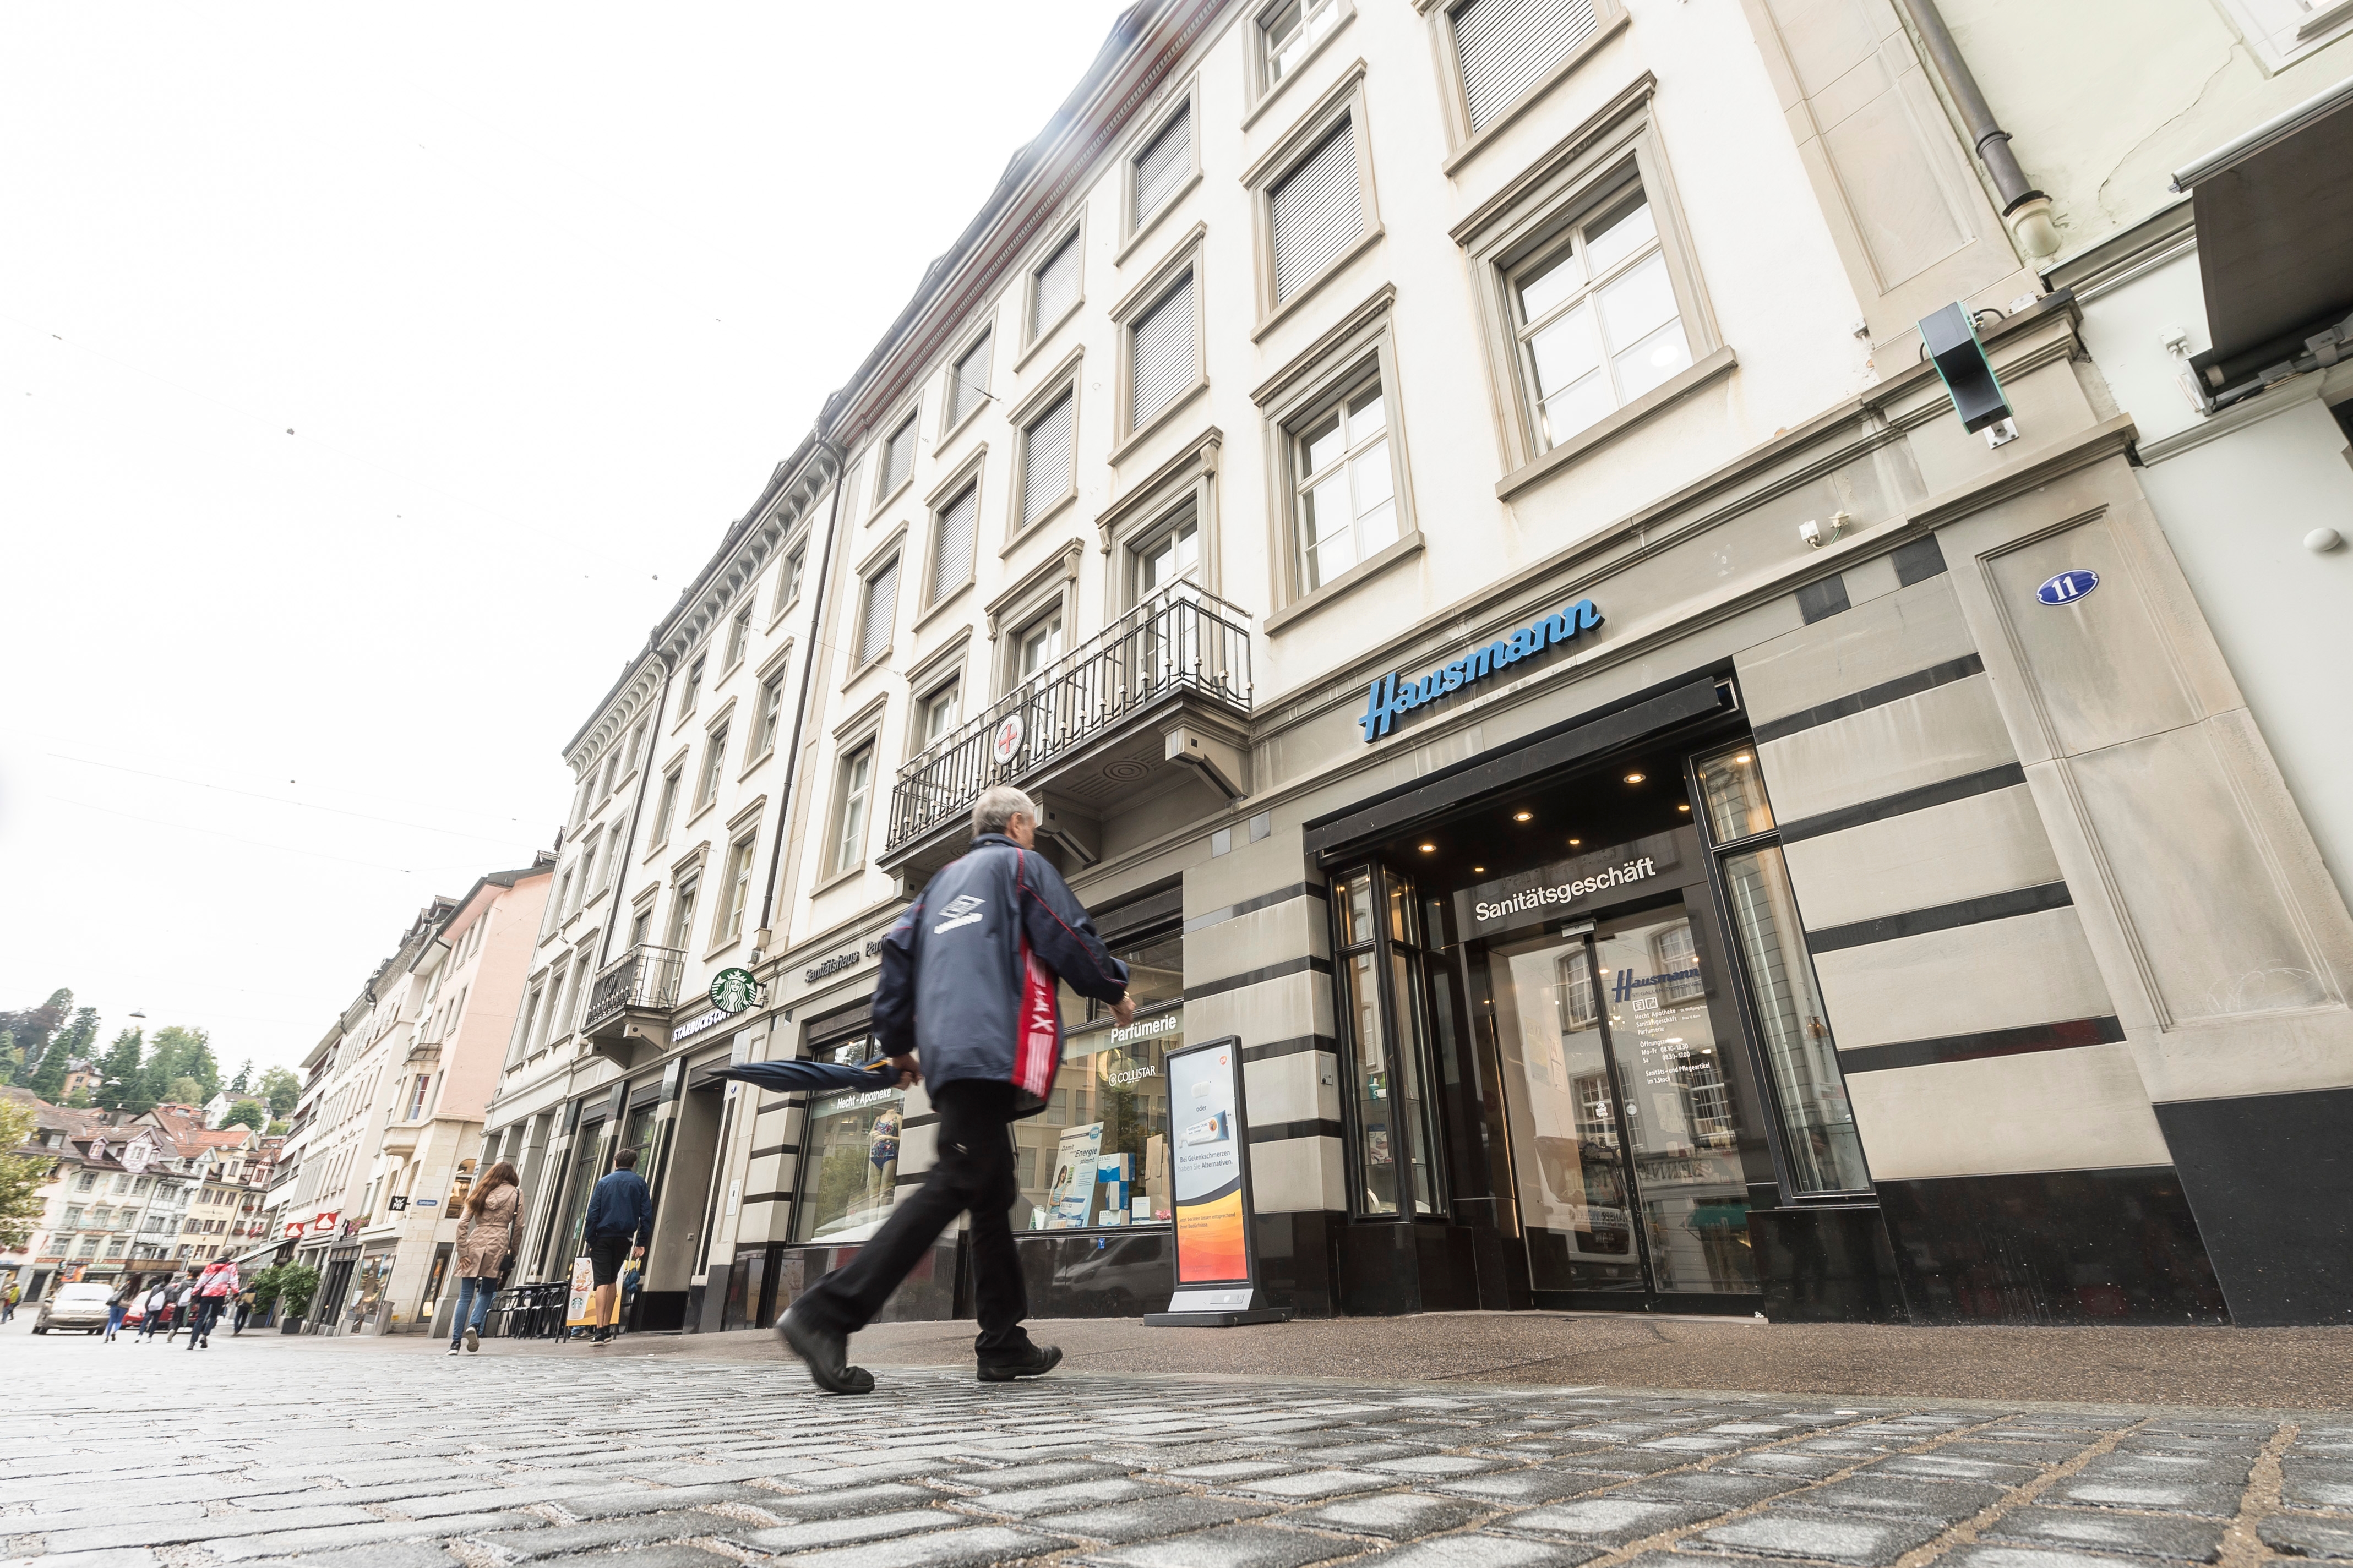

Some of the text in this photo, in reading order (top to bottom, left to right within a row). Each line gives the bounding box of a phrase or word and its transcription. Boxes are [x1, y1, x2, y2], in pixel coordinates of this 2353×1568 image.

[2051, 576, 2078, 601] 11
[1358, 599, 1601, 744] Hausmann
[1475, 857, 1656, 921] Sanitätsgeschäft
[1611, 968, 1700, 1003] Hausmann
[1652, 1008, 1676, 1018] Apotheke
[672, 1012, 715, 1042] STARBUCKS
[1110, 1014, 1177, 1043] Parfümerie
[1118, 1065, 1156, 1083] COLLISTAR
[1679, 1062, 1711, 1072] Pflegeartikel
[837, 1095, 856, 1110] Hecht
[859, 1088, 892, 1106] Apotheke
[1075, 1146, 1098, 1157] Energie
[1188, 1150, 1230, 1162] Gelenkschmerzen
[1201, 1159, 1233, 1169] Alternativen.
